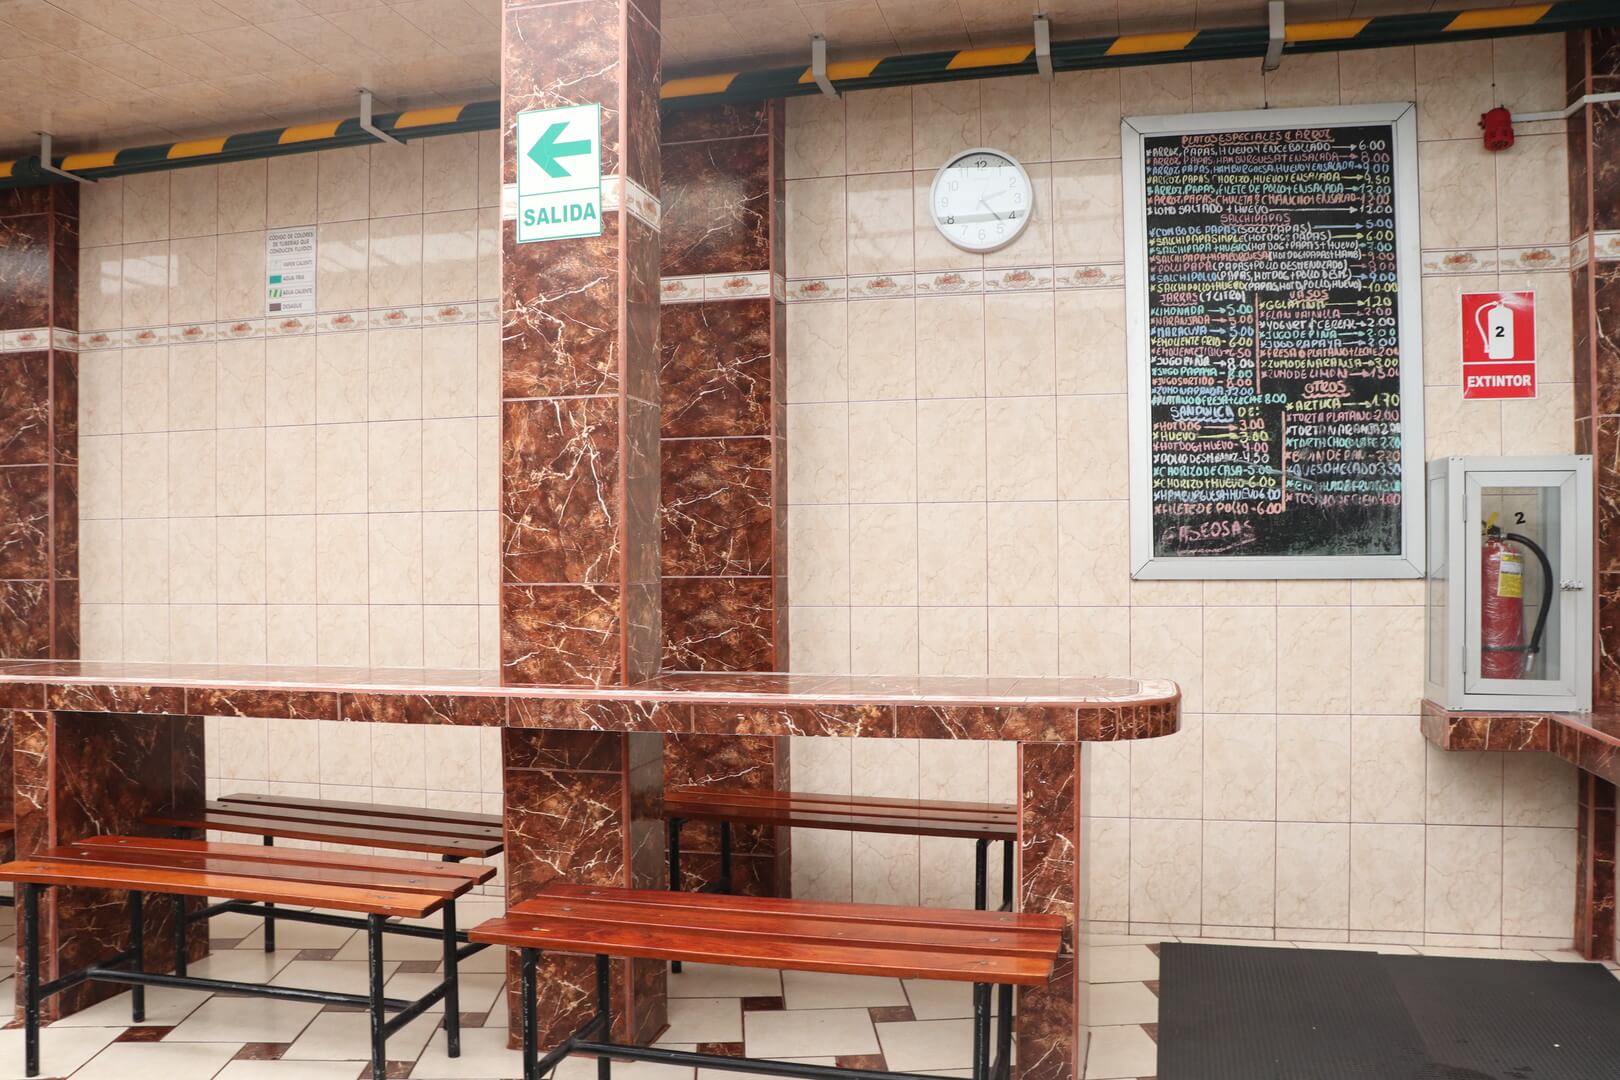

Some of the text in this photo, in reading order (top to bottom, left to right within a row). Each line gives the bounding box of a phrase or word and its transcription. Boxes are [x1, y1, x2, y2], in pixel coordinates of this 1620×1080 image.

[1182, 134, 1217, 144] PLATOS
[1218, 131, 1281, 142] ESPECIALES
[1359, 140, 1386, 151] 6.00
[1360, 151, 1390, 163] 8.00
[1362, 162, 1390, 174] 9.00
[1364, 172, 1390, 185] 9.50
[1218, 184, 1247, 194] FILETE
[1248, 184, 1260, 193] DE
[1360, 183, 1391, 195] 12.00
[1360, 193, 1390, 206] 12.00
[523, 203, 596, 226] SALIDA
[1154, 203, 1393, 215] LOMO SALTADO HUEVO 12.00
[1220, 212, 1291, 224] SALCHIPAPAS
[1155, 226, 1187, 237] COMBO
[1188, 226, 1201, 235] DE
[1205, 225, 1237, 235] PAPAS
[1269, 221, 1312, 234] PAPAS)
[1365, 218, 1393, 229] 5.00
[1365, 230, 1394, 241] 6.00
[1368, 251, 1395, 261] 9.00
[1156, 272, 1217, 282] SALCHIPOLLO
[1368, 272, 1396, 283] 9.00
[1368, 282, 1399, 293] 10.00
[1160, 292, 1198, 302] JARRAS
[1289, 288, 1329, 300] VASOS
[1155, 303, 1254, 316] LIMONADA 5.00
[1265, 299, 1326, 310] GELATINA
[1265, 309, 1292, 319] FLAN
[1365, 306, 1392, 316] 2.00
[1155, 314, 1254, 325] NARANJADA 5.00
[1266, 317, 1396, 331] YOGURT CEREAL 2.00
[1156, 325, 1254, 338] MARACUYA 5.00
[1366, 328, 1396, 338] 2.00
[1495, 326, 1505, 338] 2
[1201, 335, 1221, 347] FRIO
[1228, 337, 1253, 348] 6.00
[1265, 339, 1294, 349] JUGO
[1295, 339, 1343, 349] PAPAYA
[1267, 349, 1297, 358] FRESA
[1156, 356, 1181, 366] JUGO
[1227, 357, 1255, 371] 8.00
[1306, 359, 1362, 369] NARANJA
[1227, 369, 1253, 380] 8.00
[1309, 368, 1350, 379] LIMON
[1226, 378, 1252, 389] 8.00
[1304, 380, 1347, 393] OTROS
[1467, 374, 1532, 388] EXTINTOR
[1237, 406, 1261, 417] DE:
[1293, 411, 1324, 424] TORTA
[1326, 410, 1373, 422] PLATANO
[1160, 419, 1265, 431] HOT DOG 3.00
[1161, 431, 1269, 444] HUEVO 3.00
[1160, 441, 1269, 453] HOT HUEVO 4.00
[1160, 454, 1270, 465] POLLO 4.50
[1160, 466, 1203, 477] CHORIZO
[1202, 466, 1217, 476] DE
[1217, 465, 1243, 477] CASA
[1160, 478, 1204, 489] CHORIZO
[1248, 476, 1276, 488] 6.00
[1215, 502, 1249, 514] POLLO
[1514, 511, 1527, 525] 2
